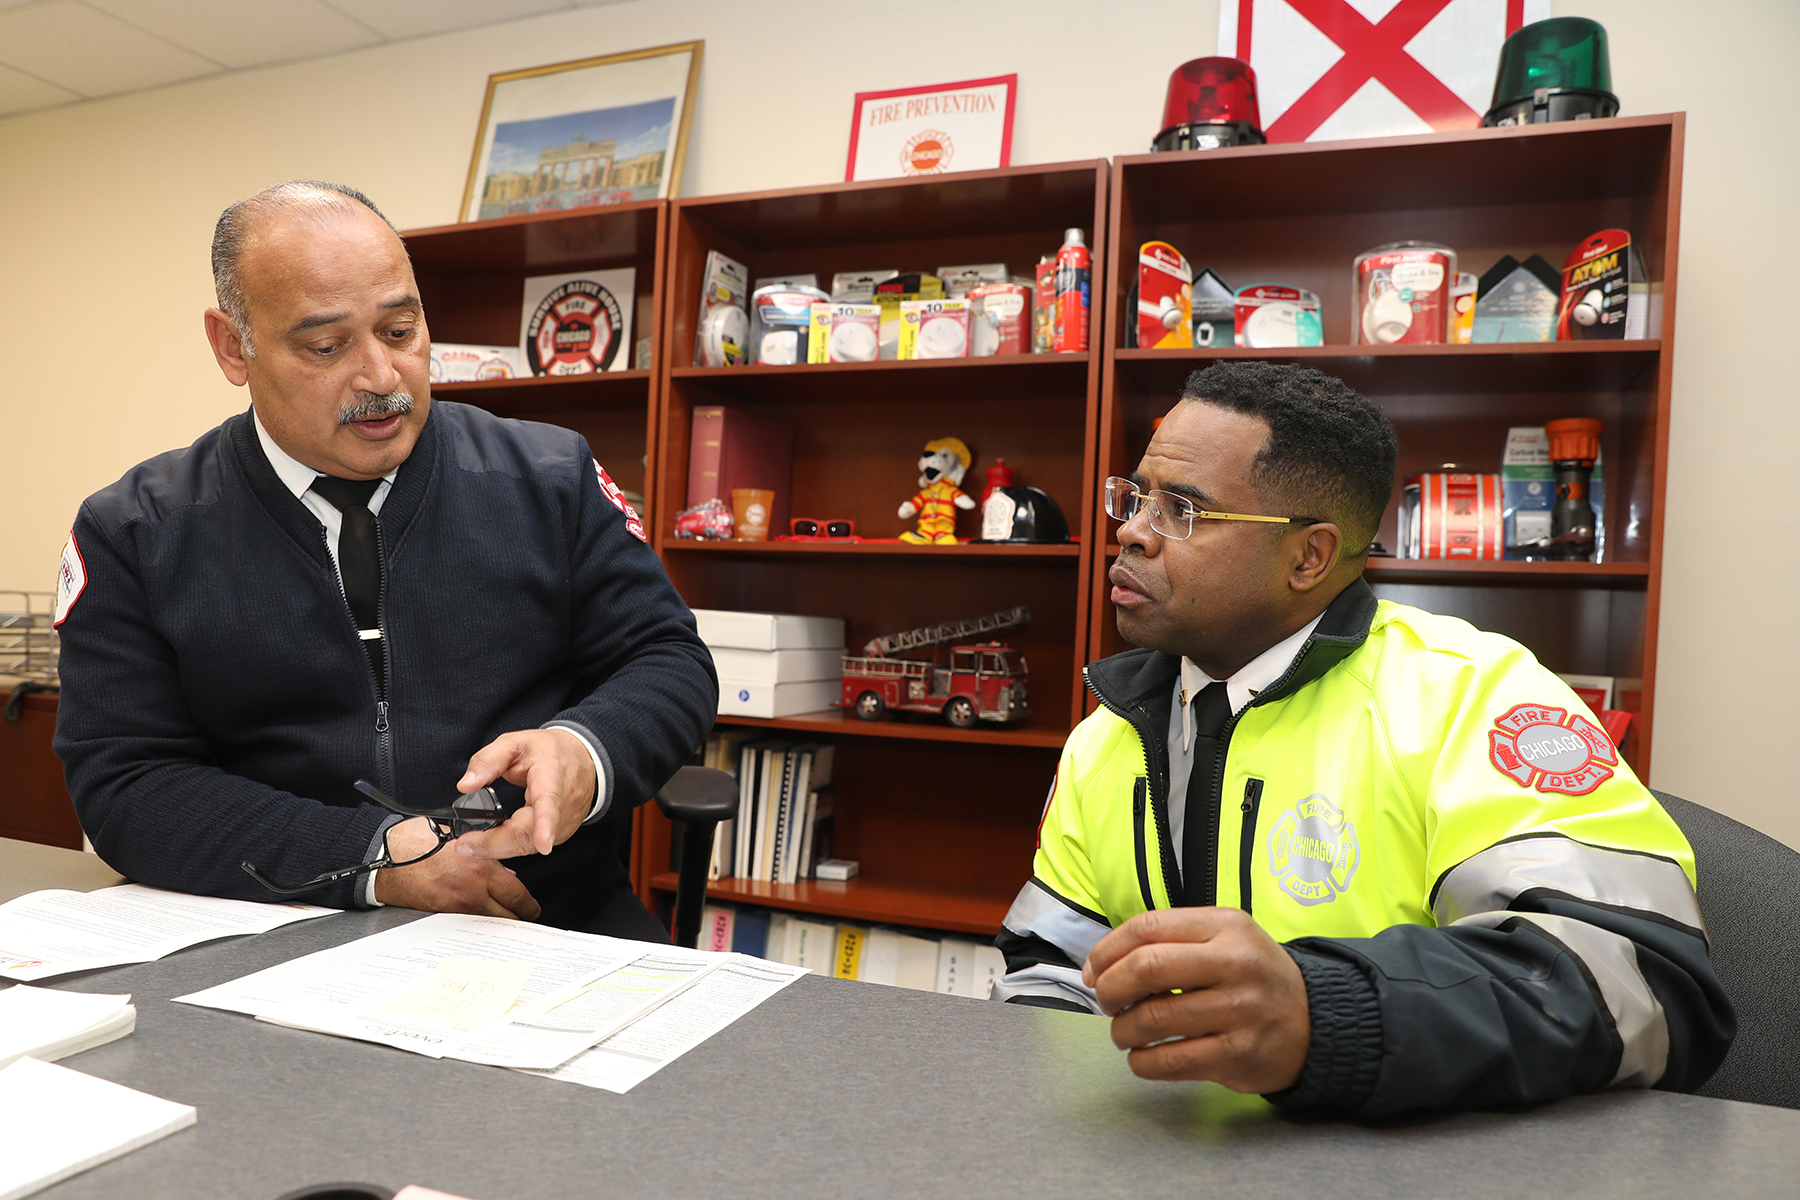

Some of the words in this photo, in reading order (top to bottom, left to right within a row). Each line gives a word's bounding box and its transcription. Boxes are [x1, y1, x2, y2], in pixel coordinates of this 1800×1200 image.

[870, 104, 902, 126] FIRE
[906, 94, 996, 118] PREVENTION
[1570, 253, 1619, 284] ATOM
[528, 287, 566, 337] SURVIVE
[567, 282, 599, 295] ALIVE
[598, 289, 621, 331] HOUSE
[566, 301, 585, 310] FIRE
[839, 308, 854, 316] 10
[927, 303, 942, 312] 10
[556, 330, 591, 343] CHICAGO
[1510, 710, 1551, 731] FIRE
[1519, 731, 1586, 763] CHICAGO
[1550, 768, 1602, 788] DEPT.
[1306, 803, 1333, 820] FIRE
[1291, 834, 1335, 864] CHICAGO
[1292, 880, 1320, 897] DEPT
